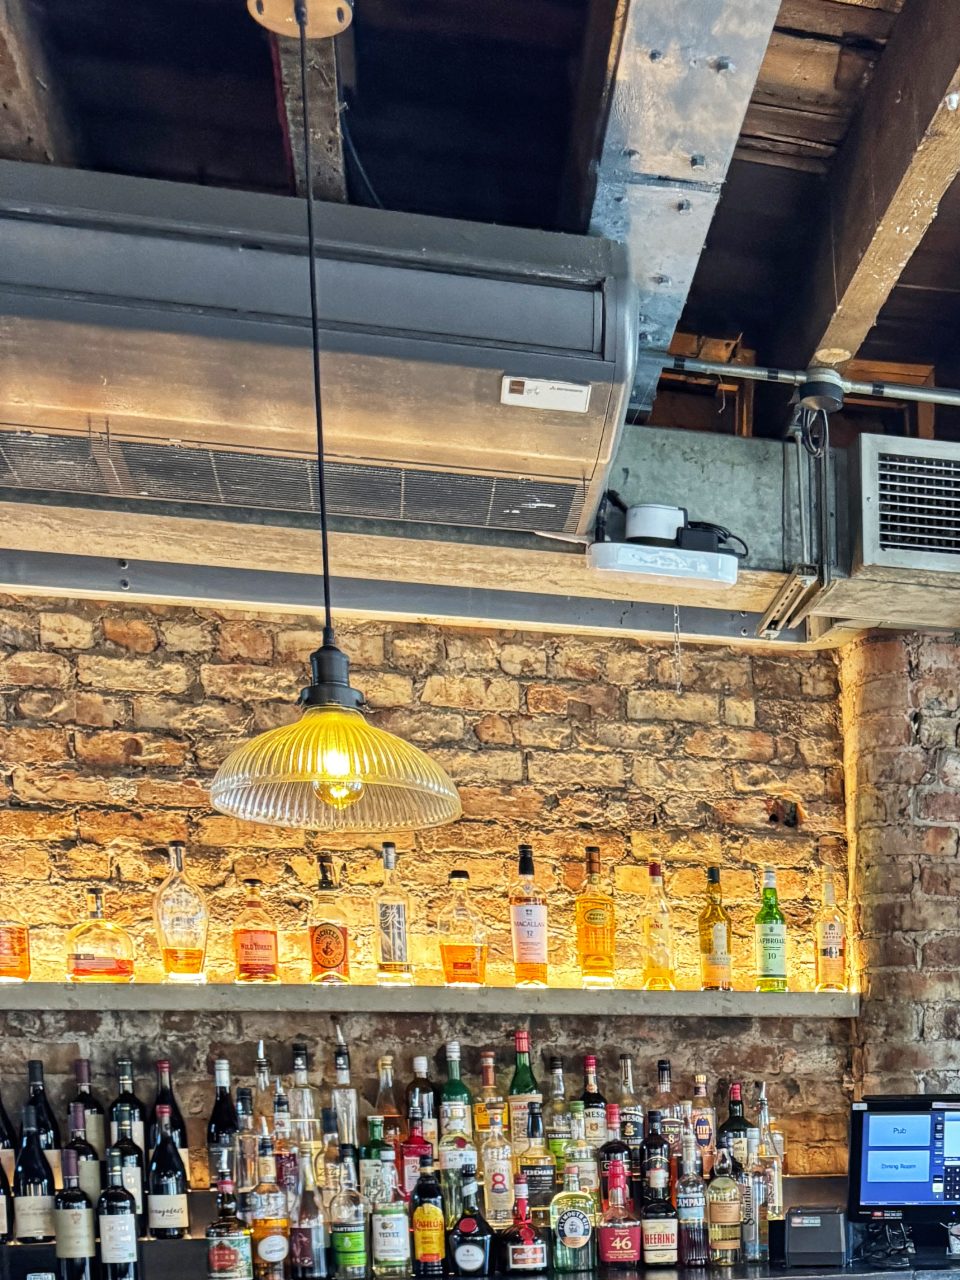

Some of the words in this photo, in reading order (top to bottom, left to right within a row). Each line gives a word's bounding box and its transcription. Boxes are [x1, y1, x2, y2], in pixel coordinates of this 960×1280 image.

[767, 951, 777, 960] 10
[892, 1127, 907, 1135] Pub
[668, 1133, 676, 1144] 8
[881, 1162, 899, 1170] Dining
[742, 1185, 756, 1226] Sagatiba
[610, 1236, 632, 1250] 46
[644, 1233, 675, 1245] HEERING
